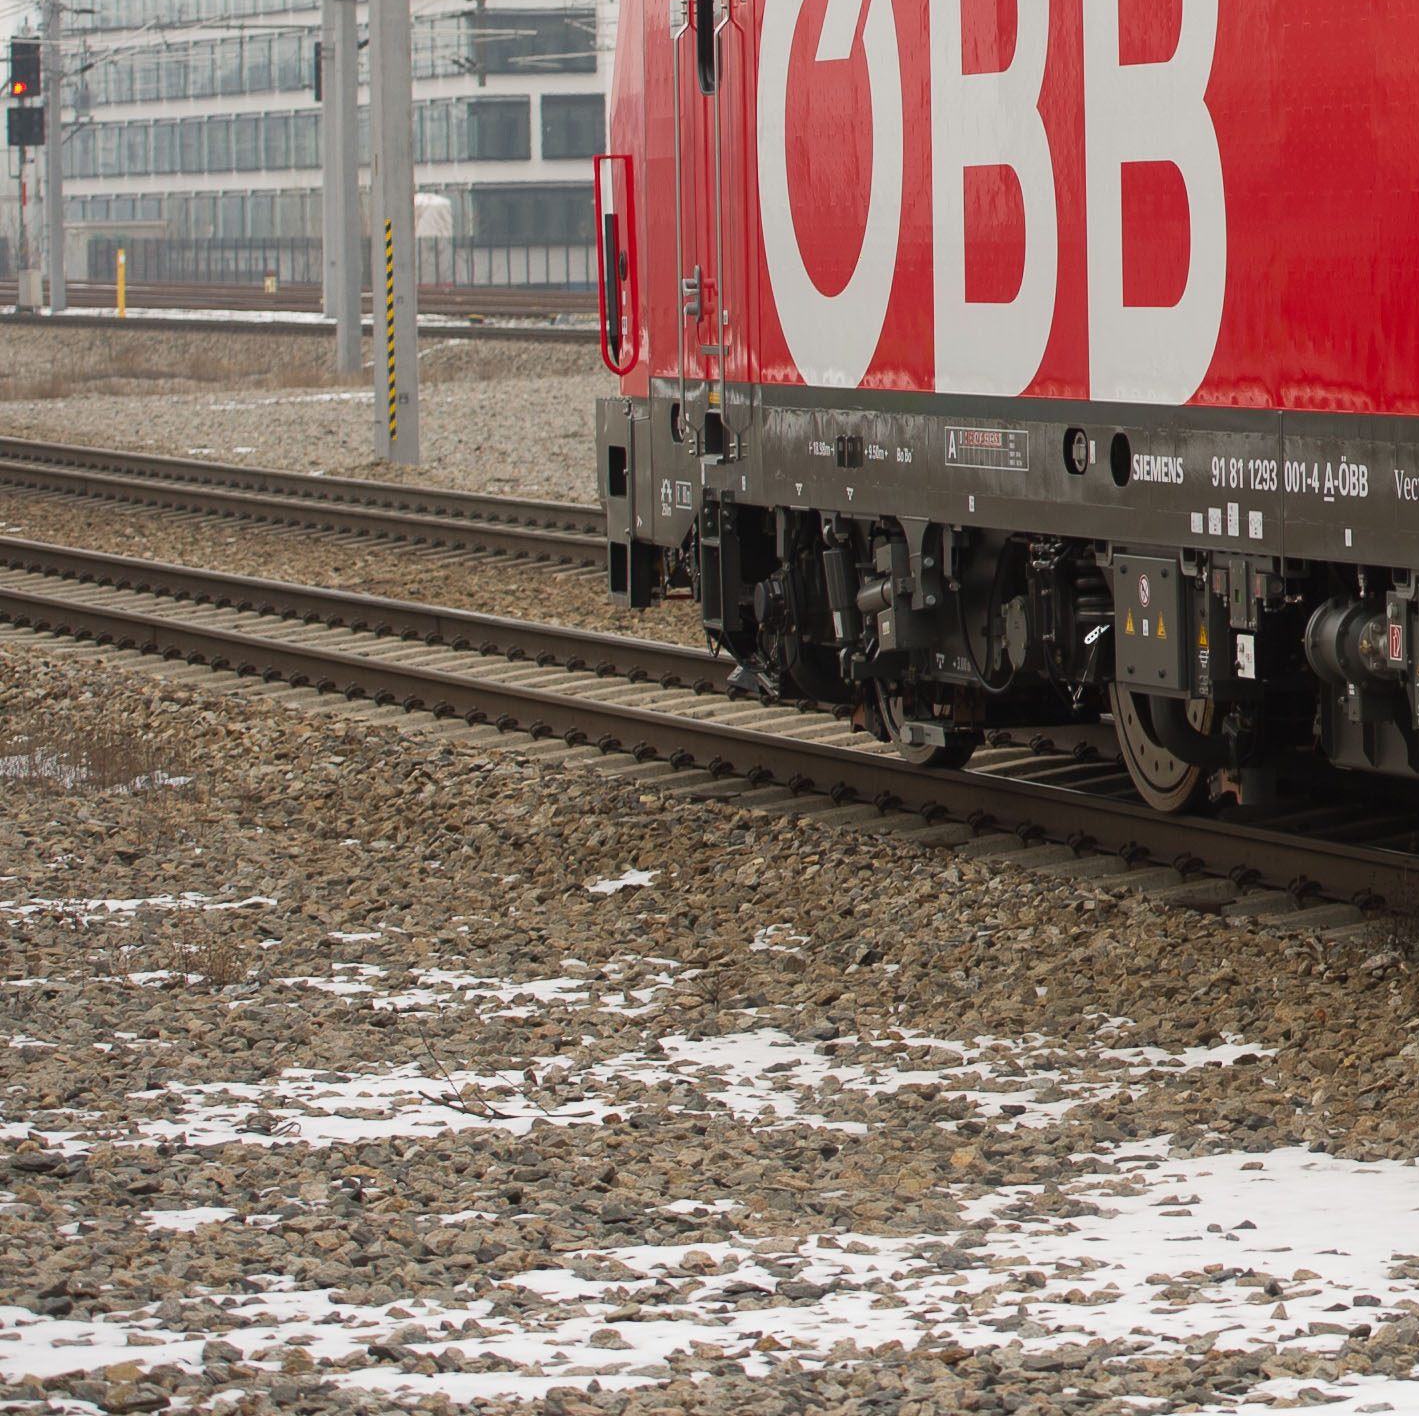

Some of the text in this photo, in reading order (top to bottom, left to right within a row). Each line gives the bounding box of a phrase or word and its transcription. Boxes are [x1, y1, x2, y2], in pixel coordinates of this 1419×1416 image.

[947, 430, 957, 460] A
[1133, 454, 1184, 484] SIEMENS
[1212, 455, 1369, 501] 91 81 1293 001-4 A-ÖBB
